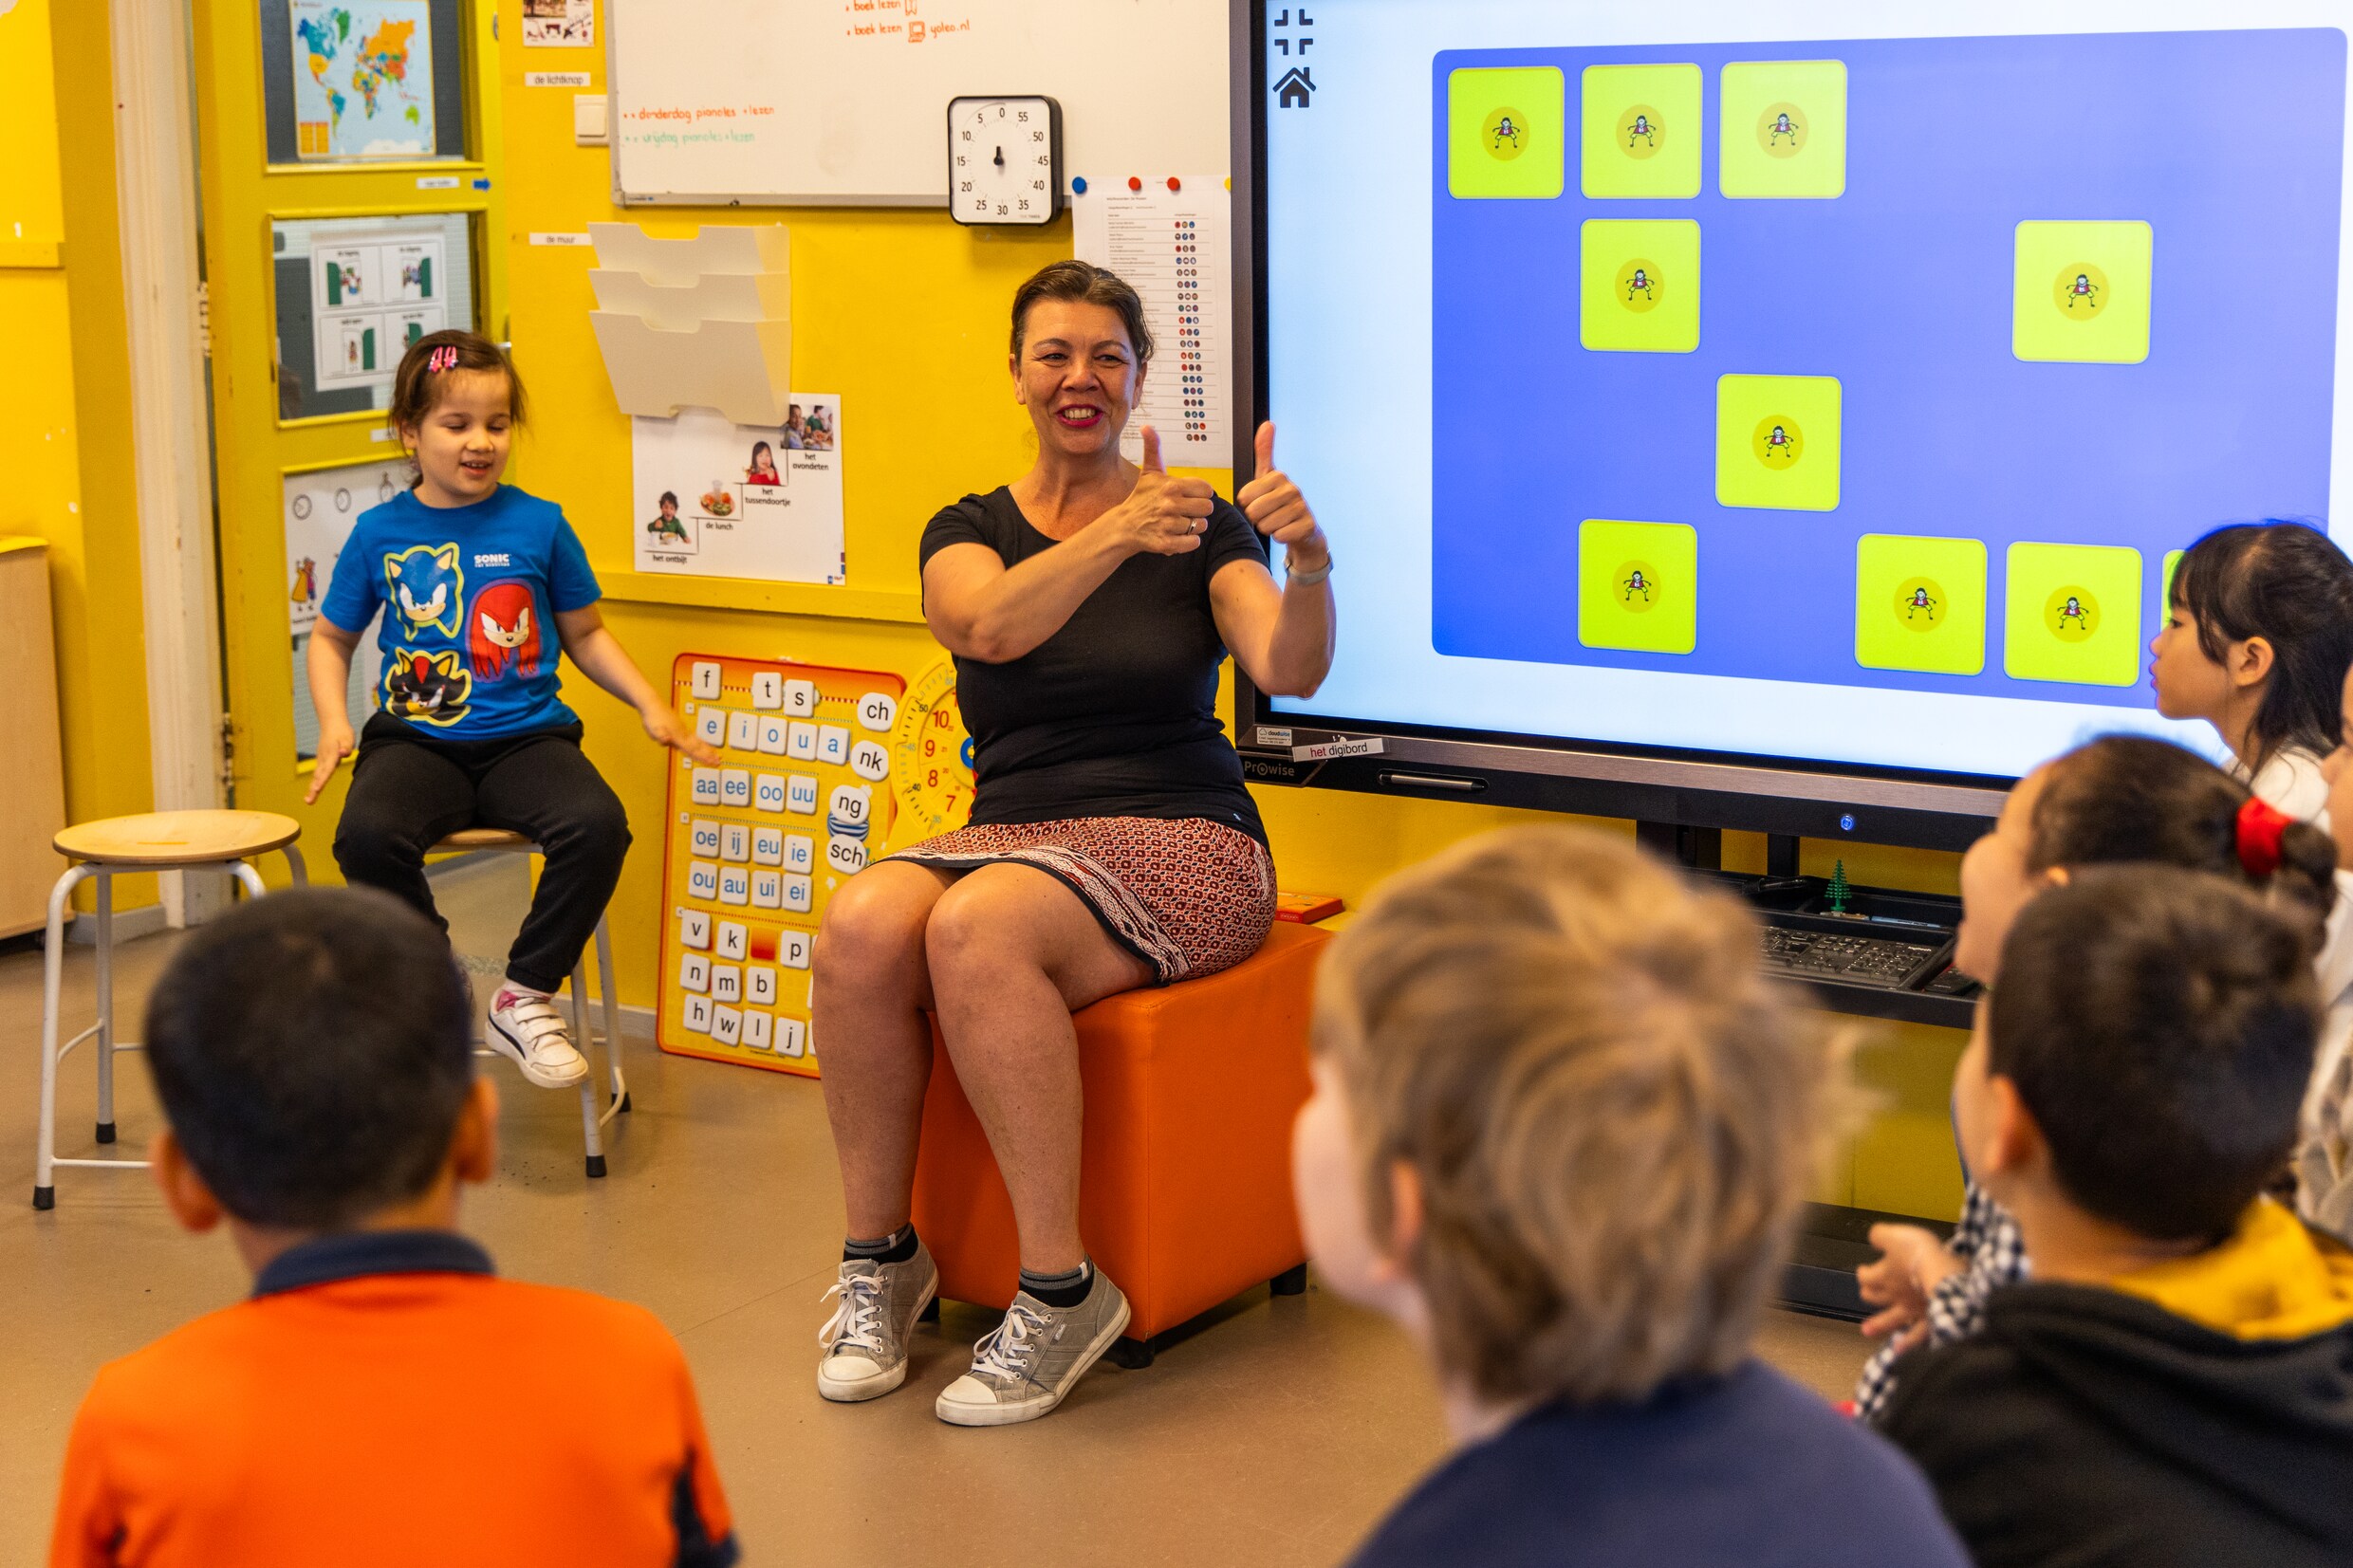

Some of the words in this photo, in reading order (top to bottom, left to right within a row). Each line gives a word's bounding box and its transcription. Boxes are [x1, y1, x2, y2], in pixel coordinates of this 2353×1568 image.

[855, 23, 876, 36] boek
[879, 23, 902, 34] lezen
[639, 106, 692, 124] donderdag
[977, 113, 984, 123] 5
[999, 107, 1006, 119] 0
[1018, 111, 1028, 122] 55
[962, 130, 972, 141] 10
[1032, 131, 1044, 142] 50
[956, 156, 966, 166] 15
[1037, 155, 1049, 166] 45
[961, 181, 973, 193] 20
[1032, 179, 1045, 191] 40
[975, 199, 988, 211] 25
[996, 205, 1009, 216] 30
[1018, 199, 1029, 211] 35
[805, 452, 816, 461] het
[762, 488, 773, 496] het
[745, 496, 791, 507] tussendoortje
[715, 522, 733, 530] lunch
[473, 553, 510, 563] SONIC
[652, 554, 664, 563] het
[665, 555, 687, 564] ontbijt
[703, 670, 711, 688] f
[765, 680, 771, 698] t
[794, 691, 805, 706] s
[866, 700, 889, 722] ch
[918, 705, 929, 713] 50
[933, 710, 950, 729] 10
[706, 719, 717, 734] e
[742, 720, 748, 738] i
[768, 729, 778, 744] o
[798, 734, 808, 748] u
[827, 737, 839, 753] a
[859, 750, 882, 772] nk
[924, 739, 936, 758] 9
[1309, 747, 1326, 758] het
[1328, 743, 1368, 758] digibord
[928, 769, 938, 787] 8
[696, 779, 718, 795] aa
[725, 781, 747, 796] ee
[759, 786, 783, 802] oo
[791, 787, 814, 803] uu
[838, 795, 862, 819] ng
[946, 794, 956, 813] 7
[695, 831, 718, 846] oe
[732, 832, 741, 855] ij
[758, 839, 779, 855] eu
[790, 841, 806, 862] ie
[830, 842, 863, 865] sch
[693, 872, 715, 889] ou
[724, 878, 746, 894] au
[759, 878, 775, 897] ui
[789, 883, 806, 902] ei
[692, 922, 702, 937] v
[728, 931, 738, 950] k
[789, 942, 802, 959] p
[690, 966, 701, 981] n
[718, 975, 734, 992] m
[756, 975, 768, 993] b
[694, 1002, 704, 1021] h
[719, 1017, 735, 1033] w
[787, 1026, 793, 1049] j
